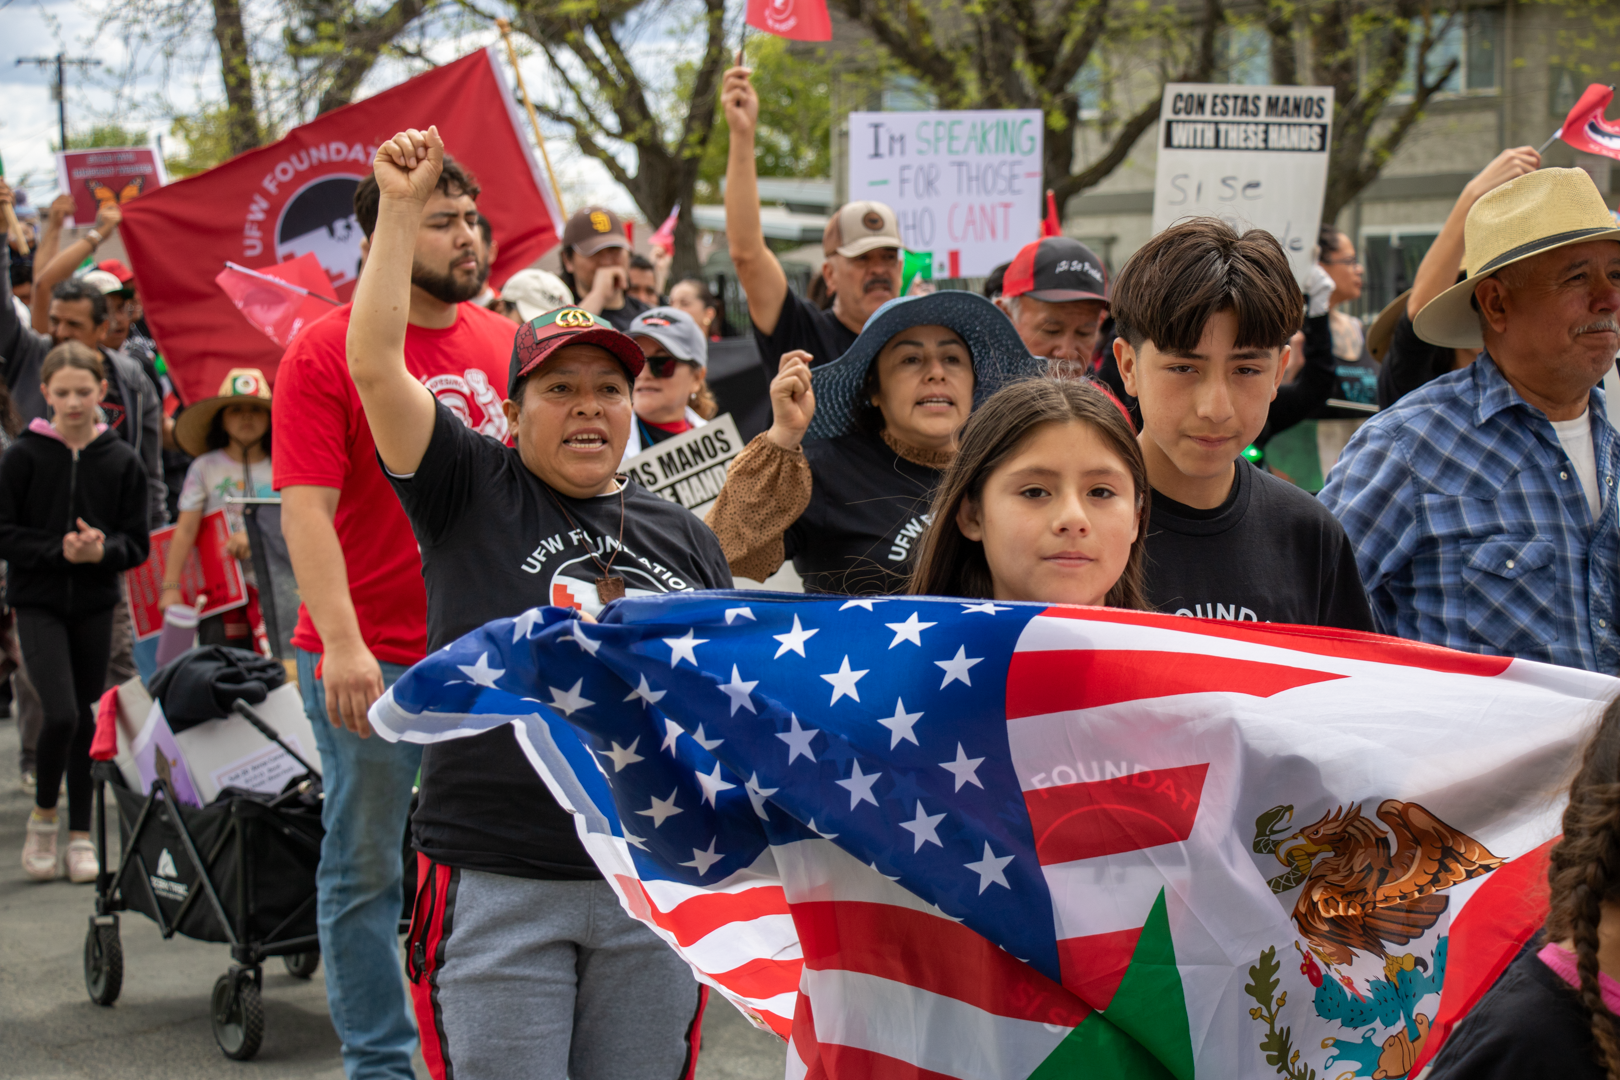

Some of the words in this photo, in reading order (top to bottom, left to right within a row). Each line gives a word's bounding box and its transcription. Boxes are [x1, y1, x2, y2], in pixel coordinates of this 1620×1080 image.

[1172, 93, 1207, 116] CON
[1210, 93, 1261, 117] ESTAS
[1265, 95, 1326, 119] MANOS
[915, 118, 1037, 156] SPEAKING
[1171, 121, 1217, 148] WITH
[1217, 122, 1268, 149] THESE
[1267, 124, 1323, 150] HANDS
[243, 193, 270, 257] UFW
[262, 141, 378, 195] FOUNDAT
[899, 163, 941, 200] FOR
[949, 160, 1025, 196] THOSE
[900, 206, 936, 248] HO
[947, 202, 1013, 243] CANT
[655, 429, 731, 479] MANOS
[521, 534, 565, 574] UFW
[887, 517, 923, 562] UFW
